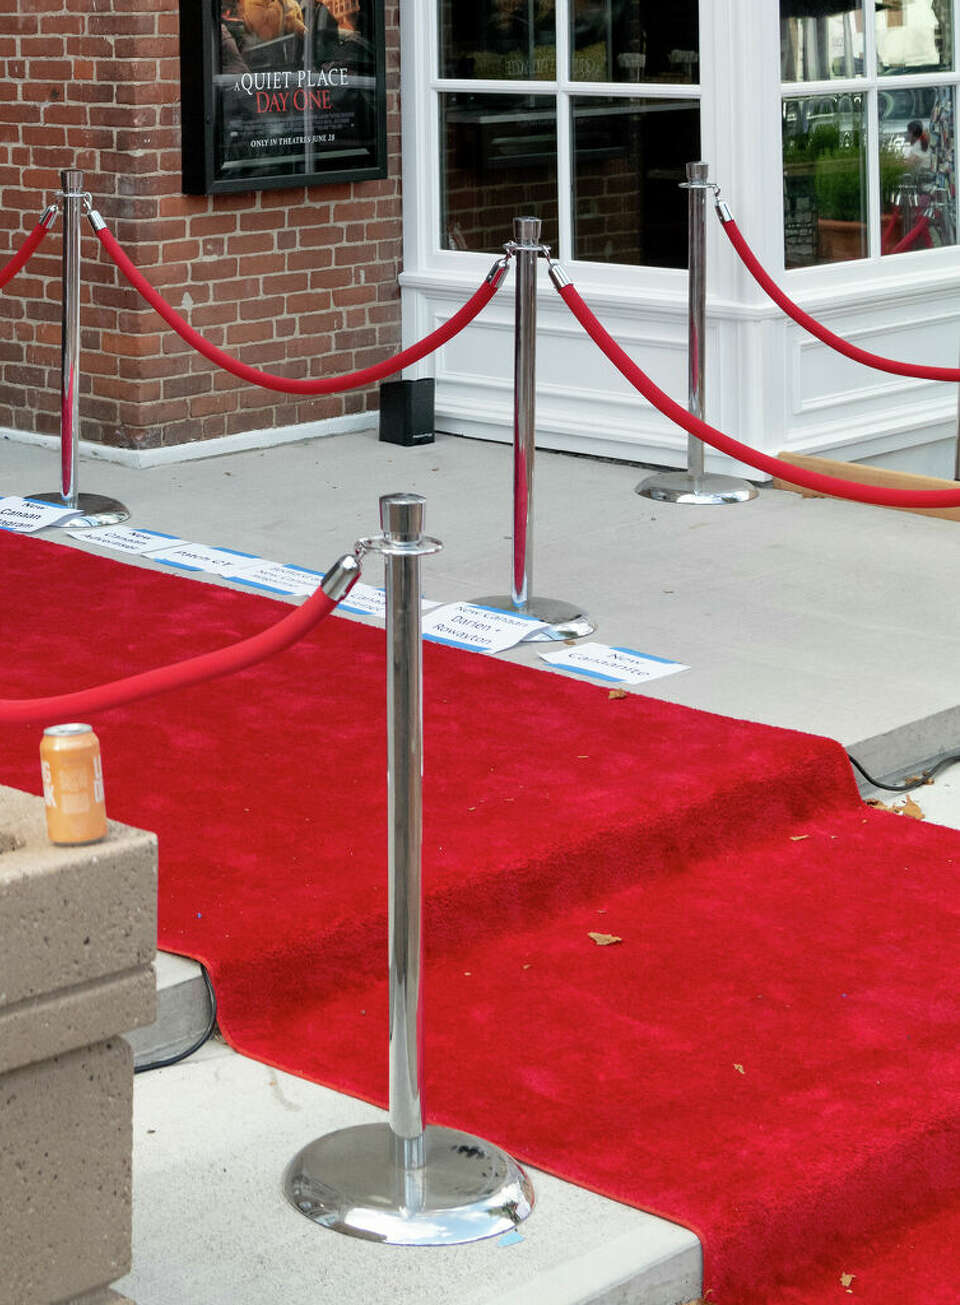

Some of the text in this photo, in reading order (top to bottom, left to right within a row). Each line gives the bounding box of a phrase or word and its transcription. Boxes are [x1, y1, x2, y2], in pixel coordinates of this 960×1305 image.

[233, 67, 349, 96] A QUIET PLACE
[255, 88, 334, 114] DAY ONE
[250, 138, 269, 148] ONLY
[270, 138, 278, 146] IN
[311, 134, 327, 145] JUNE
[0, 508, 42, 520] Canaan
[22, 502, 45, 510] New
[451, 615, 492, 632] Darien
[433, 623, 492, 645] Rowayton
